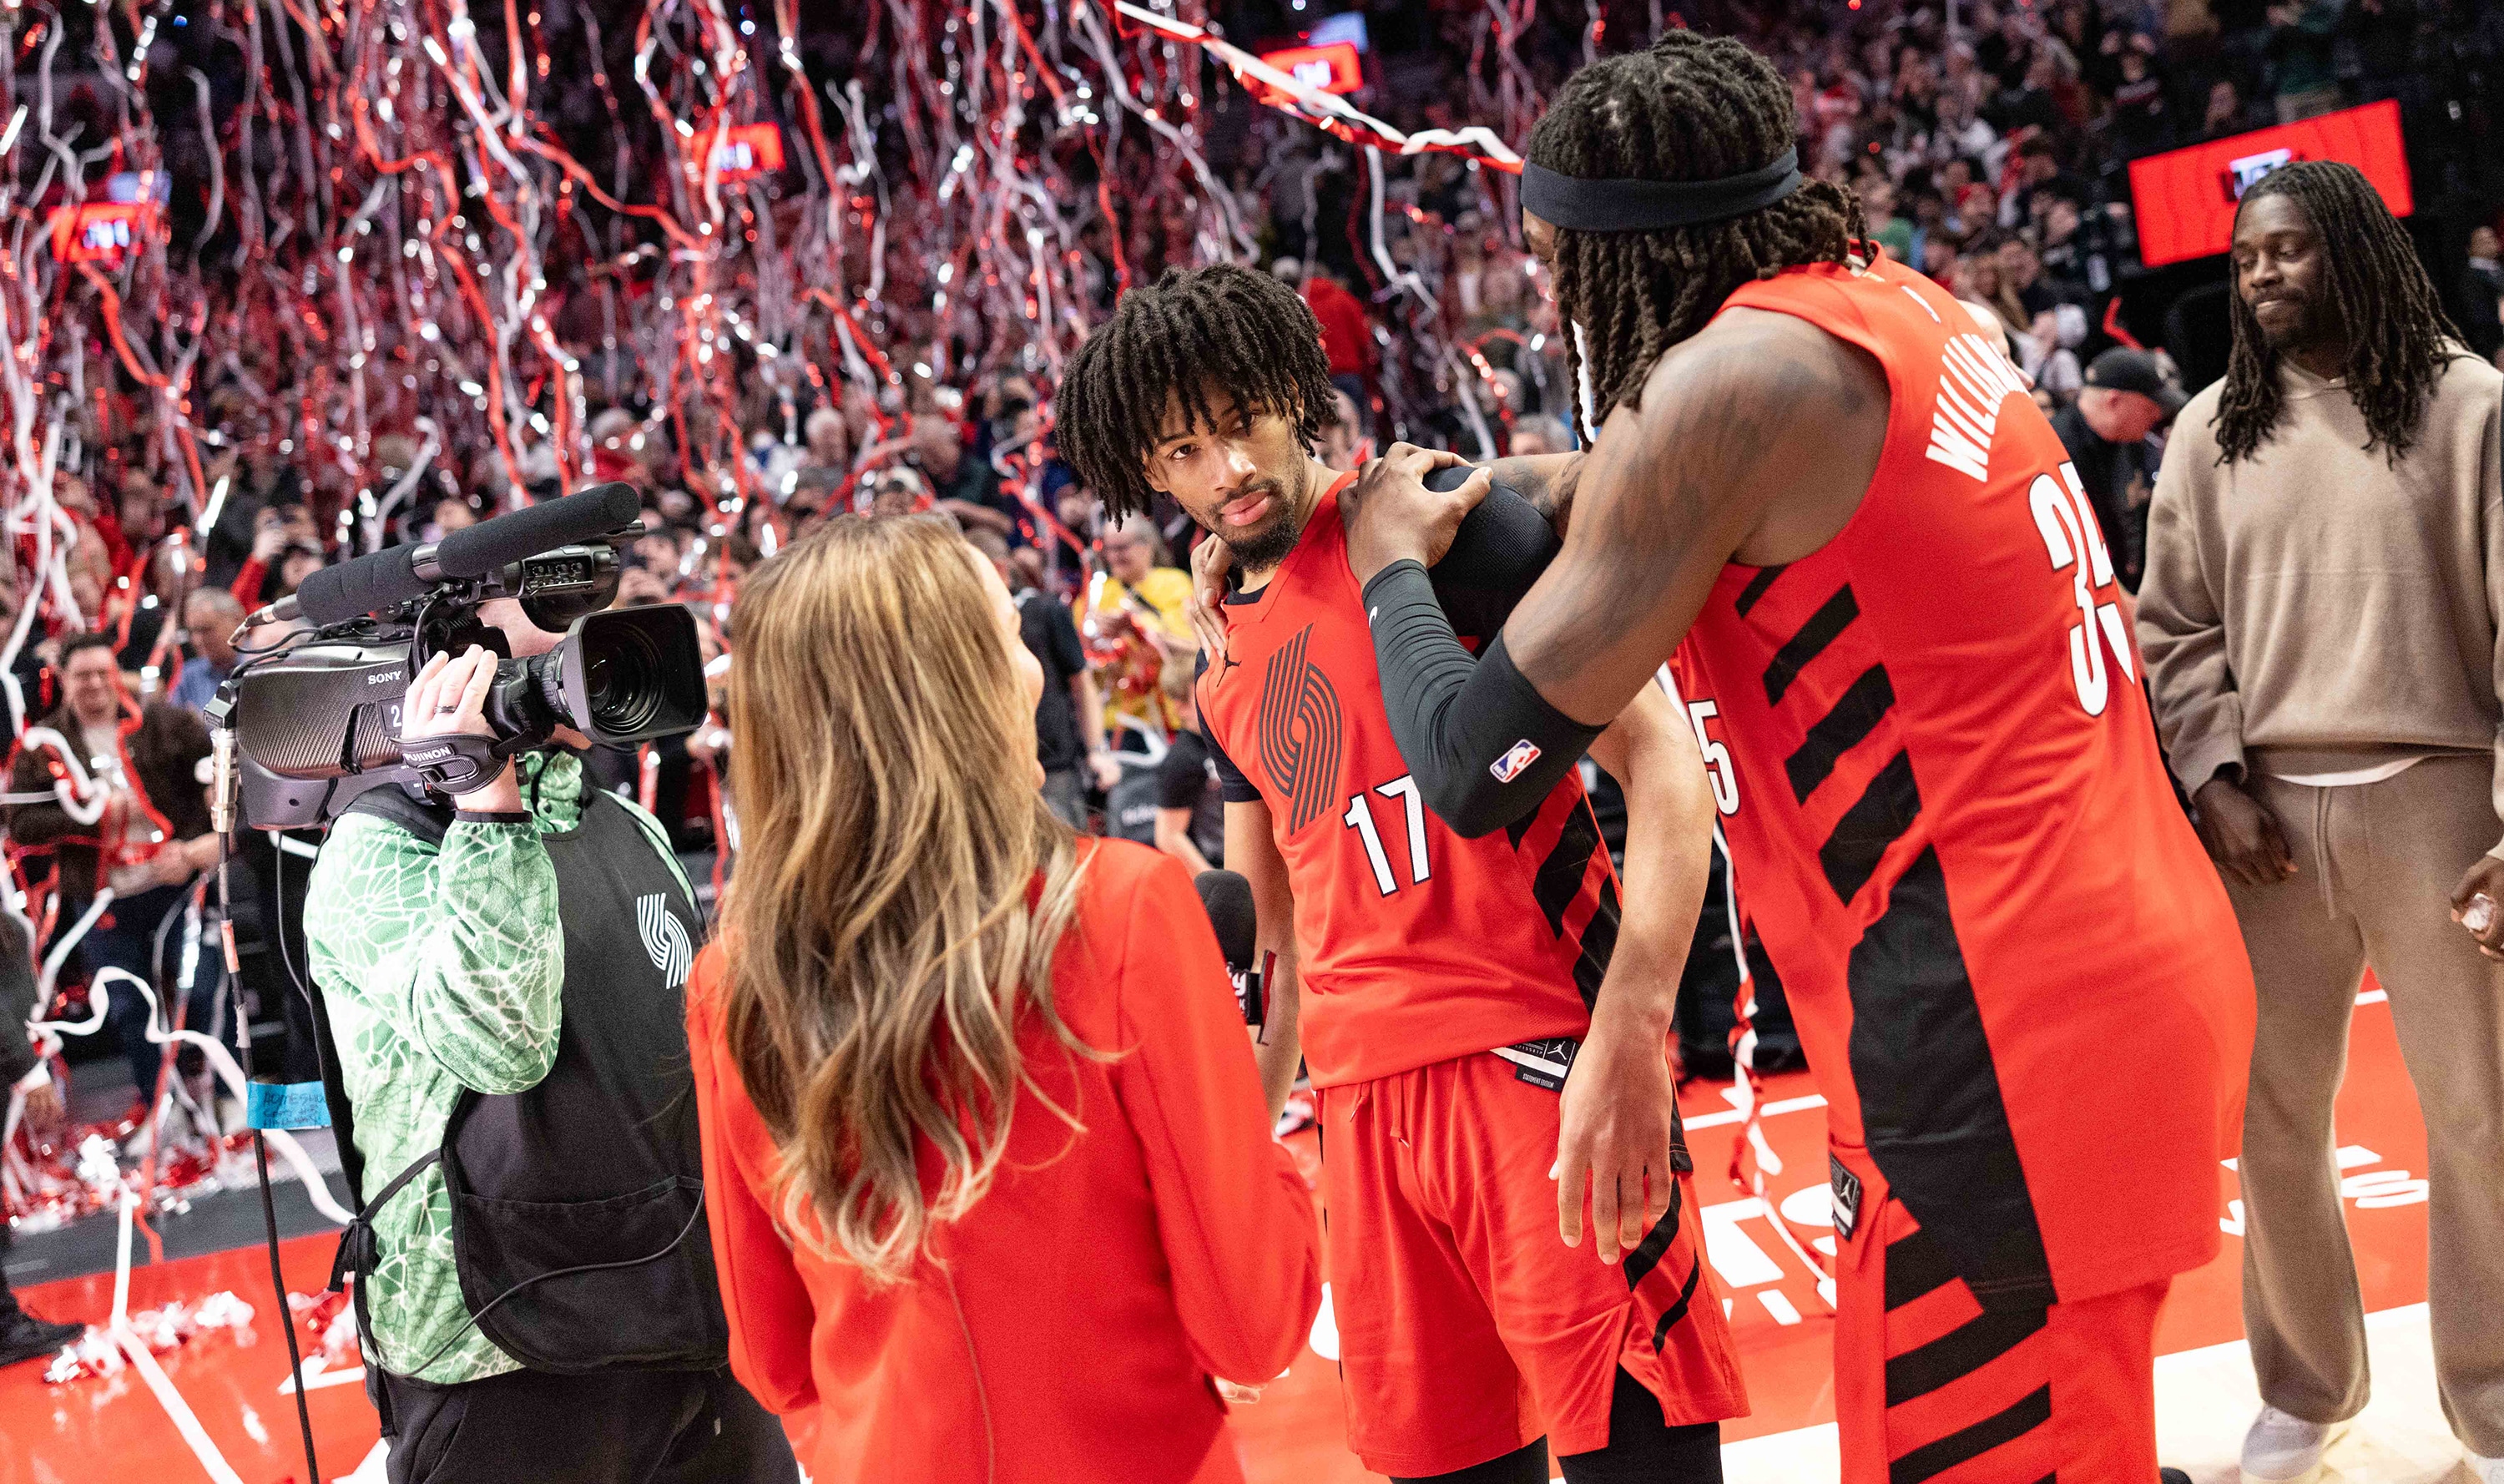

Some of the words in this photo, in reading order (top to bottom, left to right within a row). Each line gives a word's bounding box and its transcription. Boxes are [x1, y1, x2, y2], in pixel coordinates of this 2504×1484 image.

[1926, 333, 2032, 482] WILLIAM
[367, 671, 402, 684] SONY
[402, 747, 451, 761] FUJINON
[1342, 772, 1432, 899] 17
